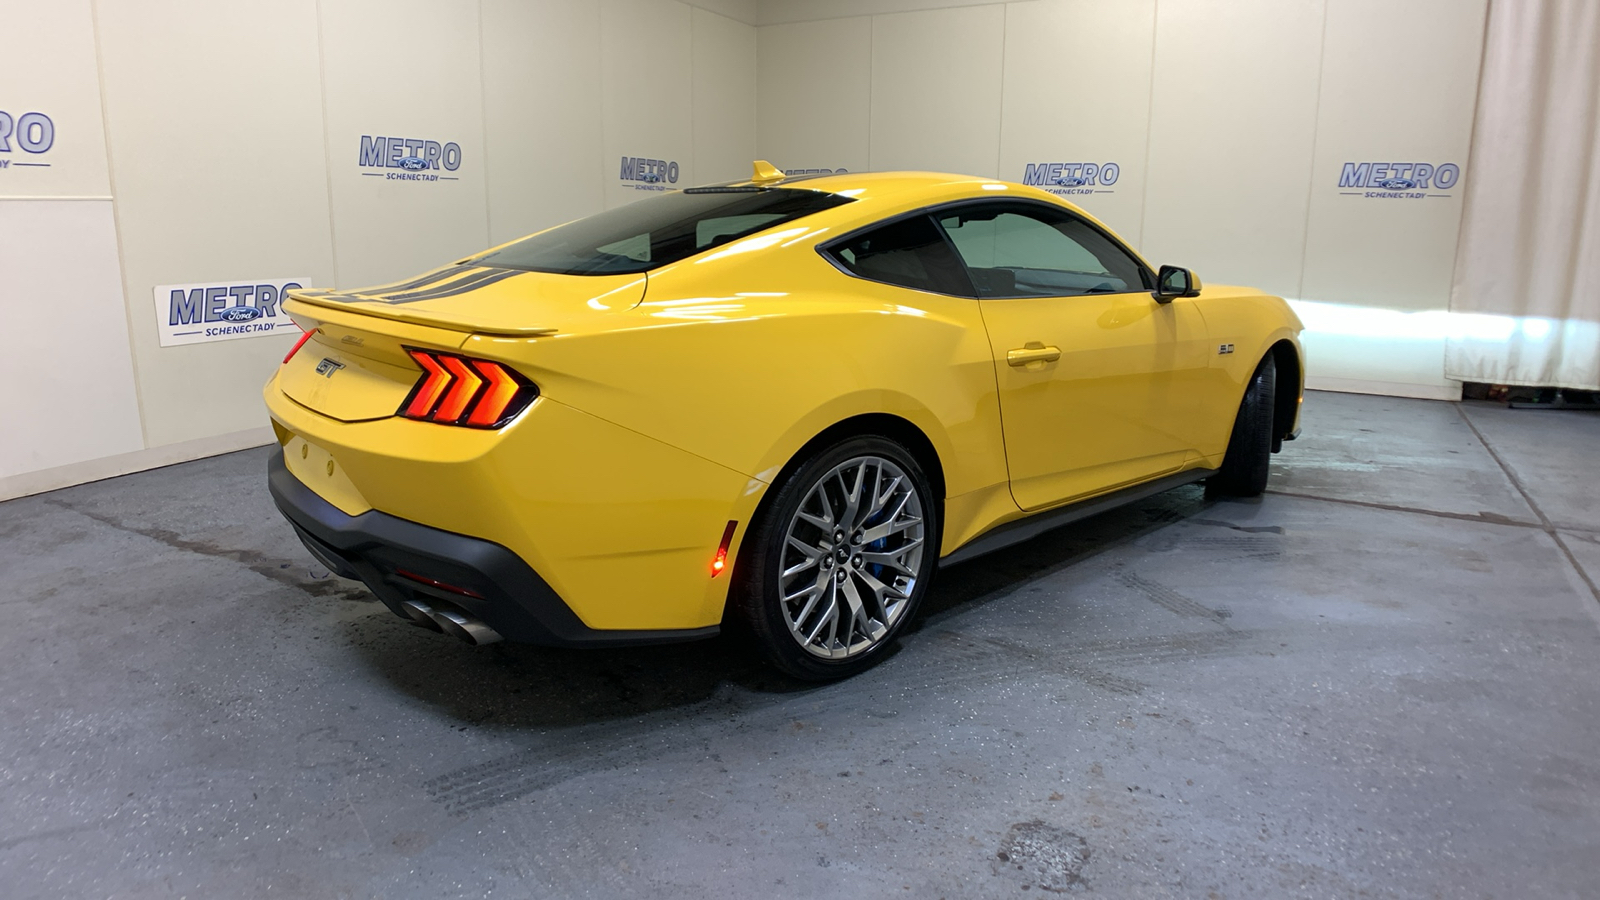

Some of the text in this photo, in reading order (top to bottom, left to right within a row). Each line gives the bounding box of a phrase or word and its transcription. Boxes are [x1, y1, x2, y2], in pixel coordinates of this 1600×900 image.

[359, 135, 462, 171] METRO
[386, 172, 439, 181] SCHENECTADY
[620, 157, 679, 183] METRO
[1023, 163, 1120, 186] METRO
[1338, 162, 1460, 189] METRO
[1364, 191, 1426, 199] SCHENECTADY
[228, 308, 252, 321] Ford
[206, 322, 275, 336] SCHENECTADY
[315, 357, 346, 379] GT
